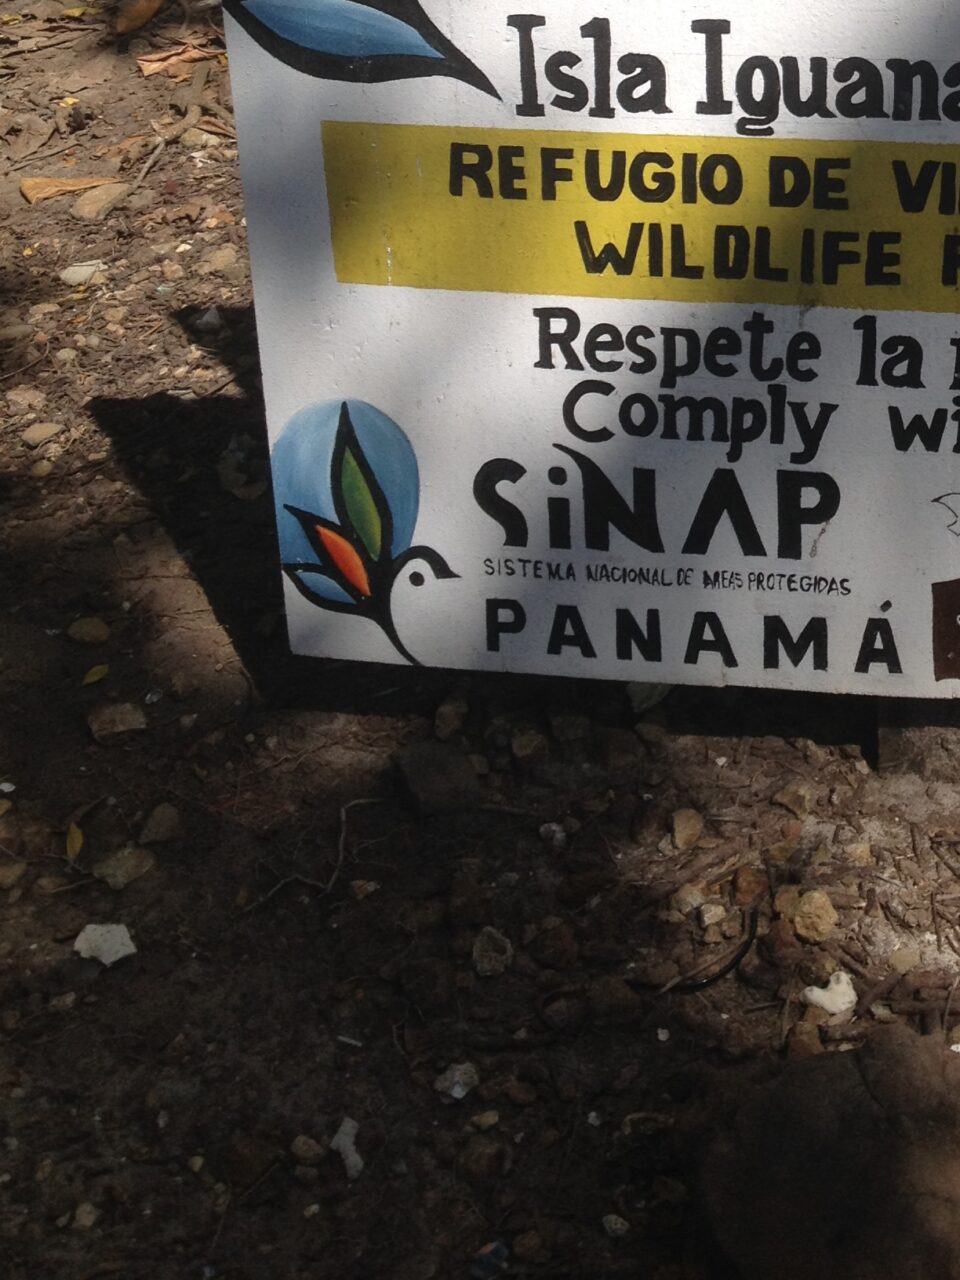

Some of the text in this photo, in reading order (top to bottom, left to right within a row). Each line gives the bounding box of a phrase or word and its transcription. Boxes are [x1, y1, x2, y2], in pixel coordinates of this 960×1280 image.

[507, 14, 672, 119] Isla
[449, 143, 743, 204] REFUGIO
[768, 156, 851, 210] DE
[574, 221, 901, 285] WILDLIFE
[533, 307, 822, 388] Respete
[853, 315, 926, 389] la
[562, 380, 839, 464] Comply
[483, 559, 576, 581] SISTEMA
[586, 564, 673, 586] NACIONAL
[675, 568, 694, 586] DE
[748, 573, 851, 596] PROTEGIDAS
[486, 599, 903, 674] PANAMÁ
